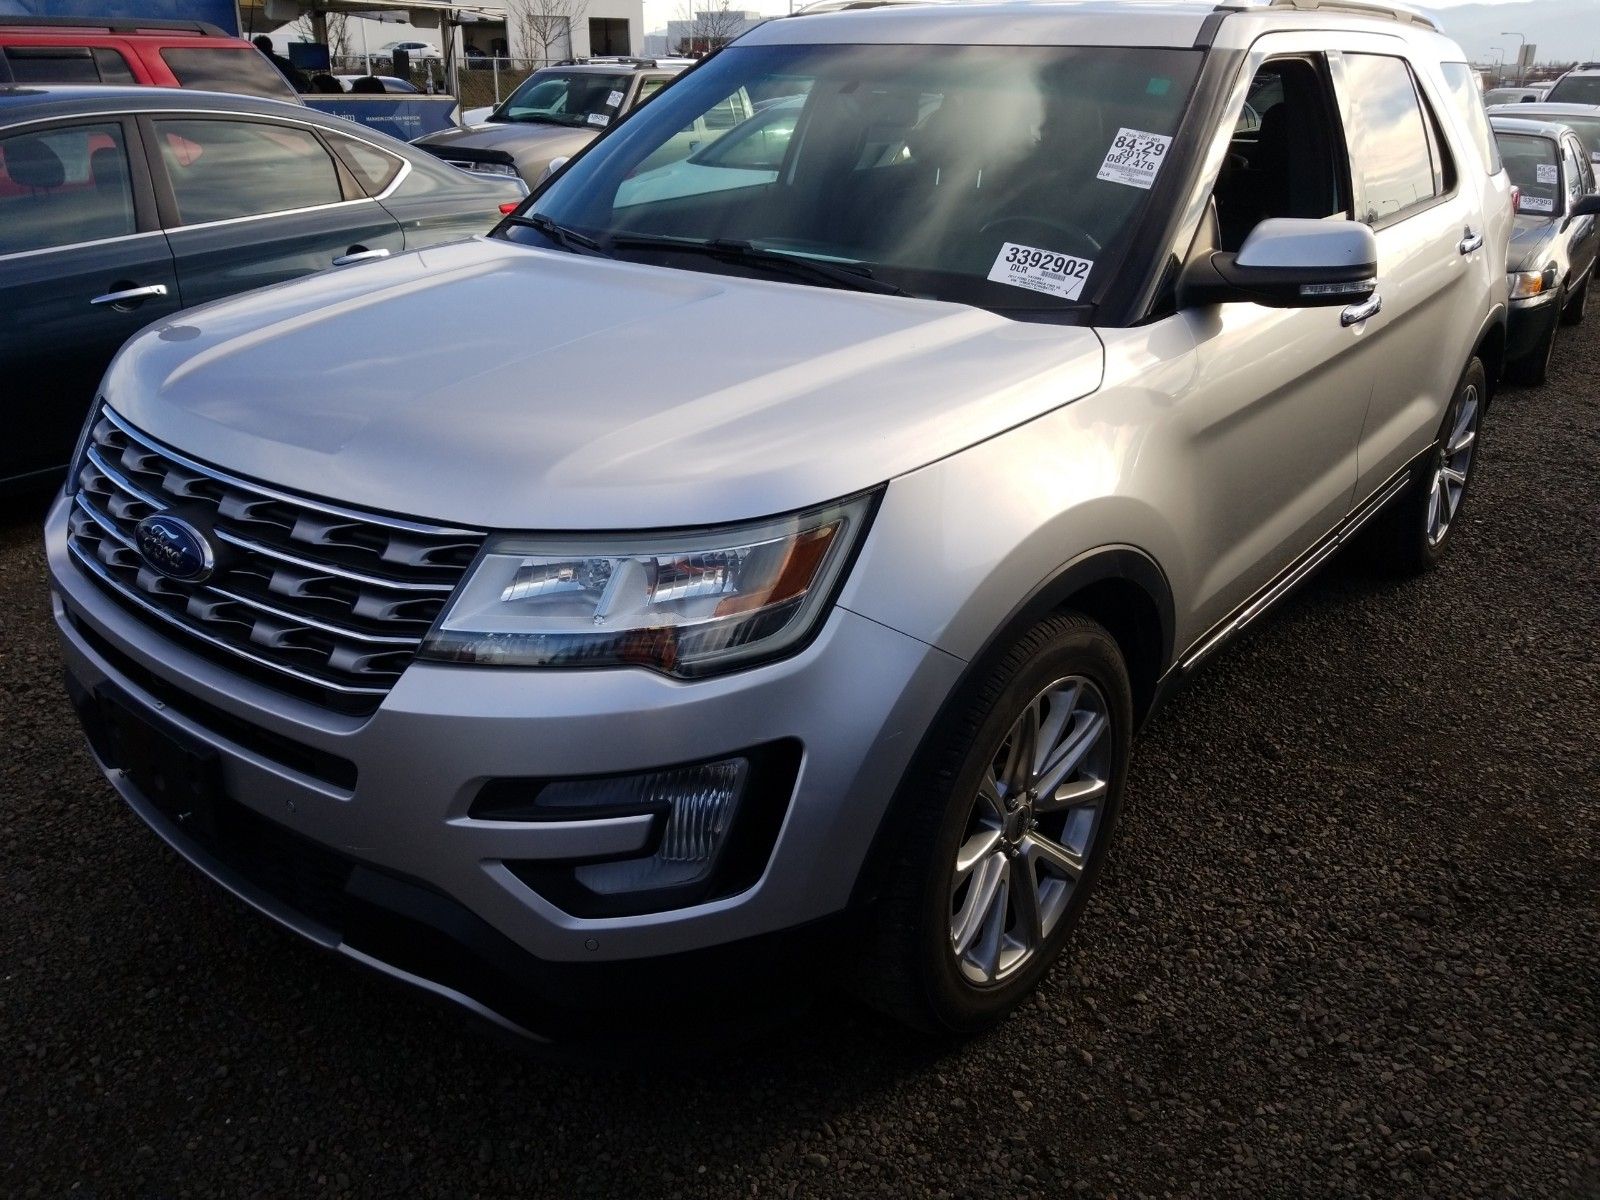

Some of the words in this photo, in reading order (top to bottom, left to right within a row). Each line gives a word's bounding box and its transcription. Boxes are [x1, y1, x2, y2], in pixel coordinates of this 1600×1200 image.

[1119, 148, 1150, 160] 2017
[1005, 247, 1089, 280] 3392902
[1009, 263, 1029, 275] DLR
[142, 524, 189, 569] Ford
